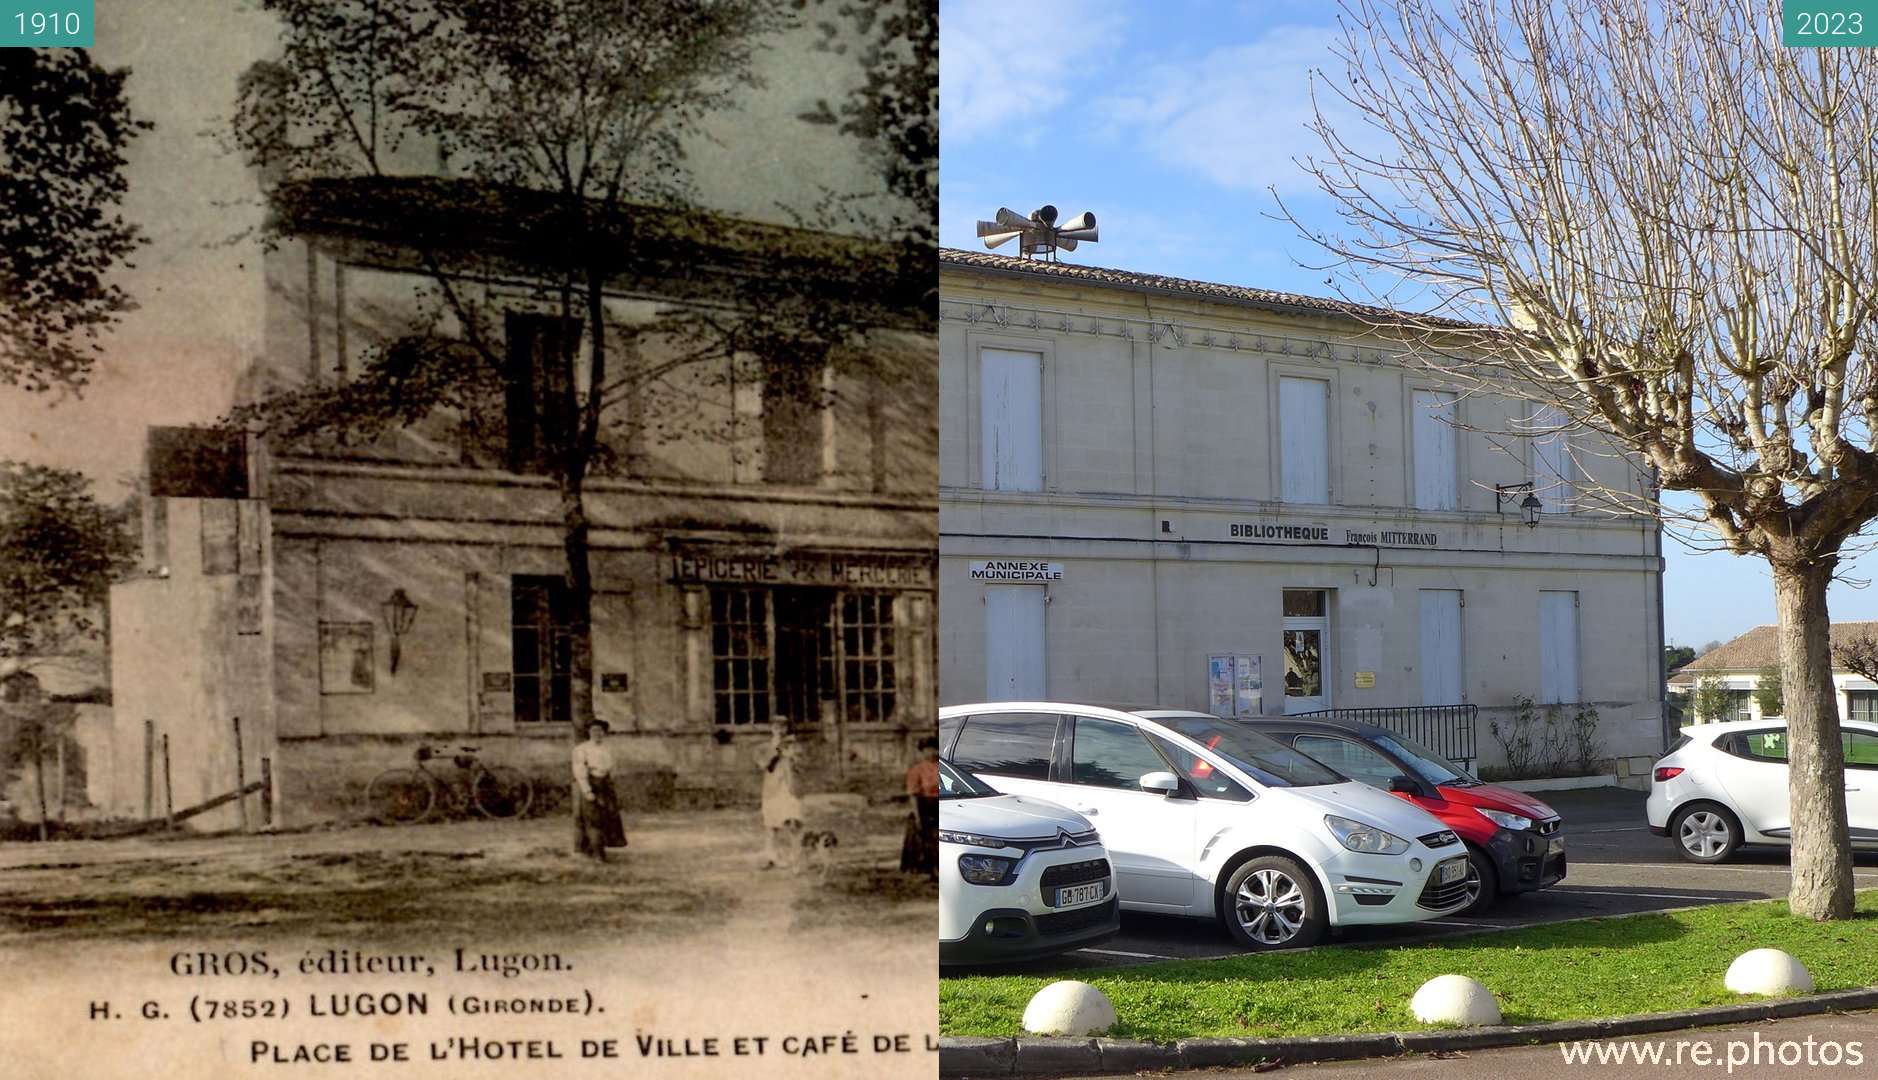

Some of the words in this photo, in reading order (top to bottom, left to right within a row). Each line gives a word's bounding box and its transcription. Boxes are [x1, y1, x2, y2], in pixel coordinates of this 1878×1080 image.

[1230, 524, 1329, 541] BIBLIOTHEQUE
[1345, 529, 1377, 544] François
[1380, 531, 1437, 546] MITTERRAND
[985, 561, 1049, 571] ANNEXE
[971, 570, 1062, 580] MUNICIPALE
